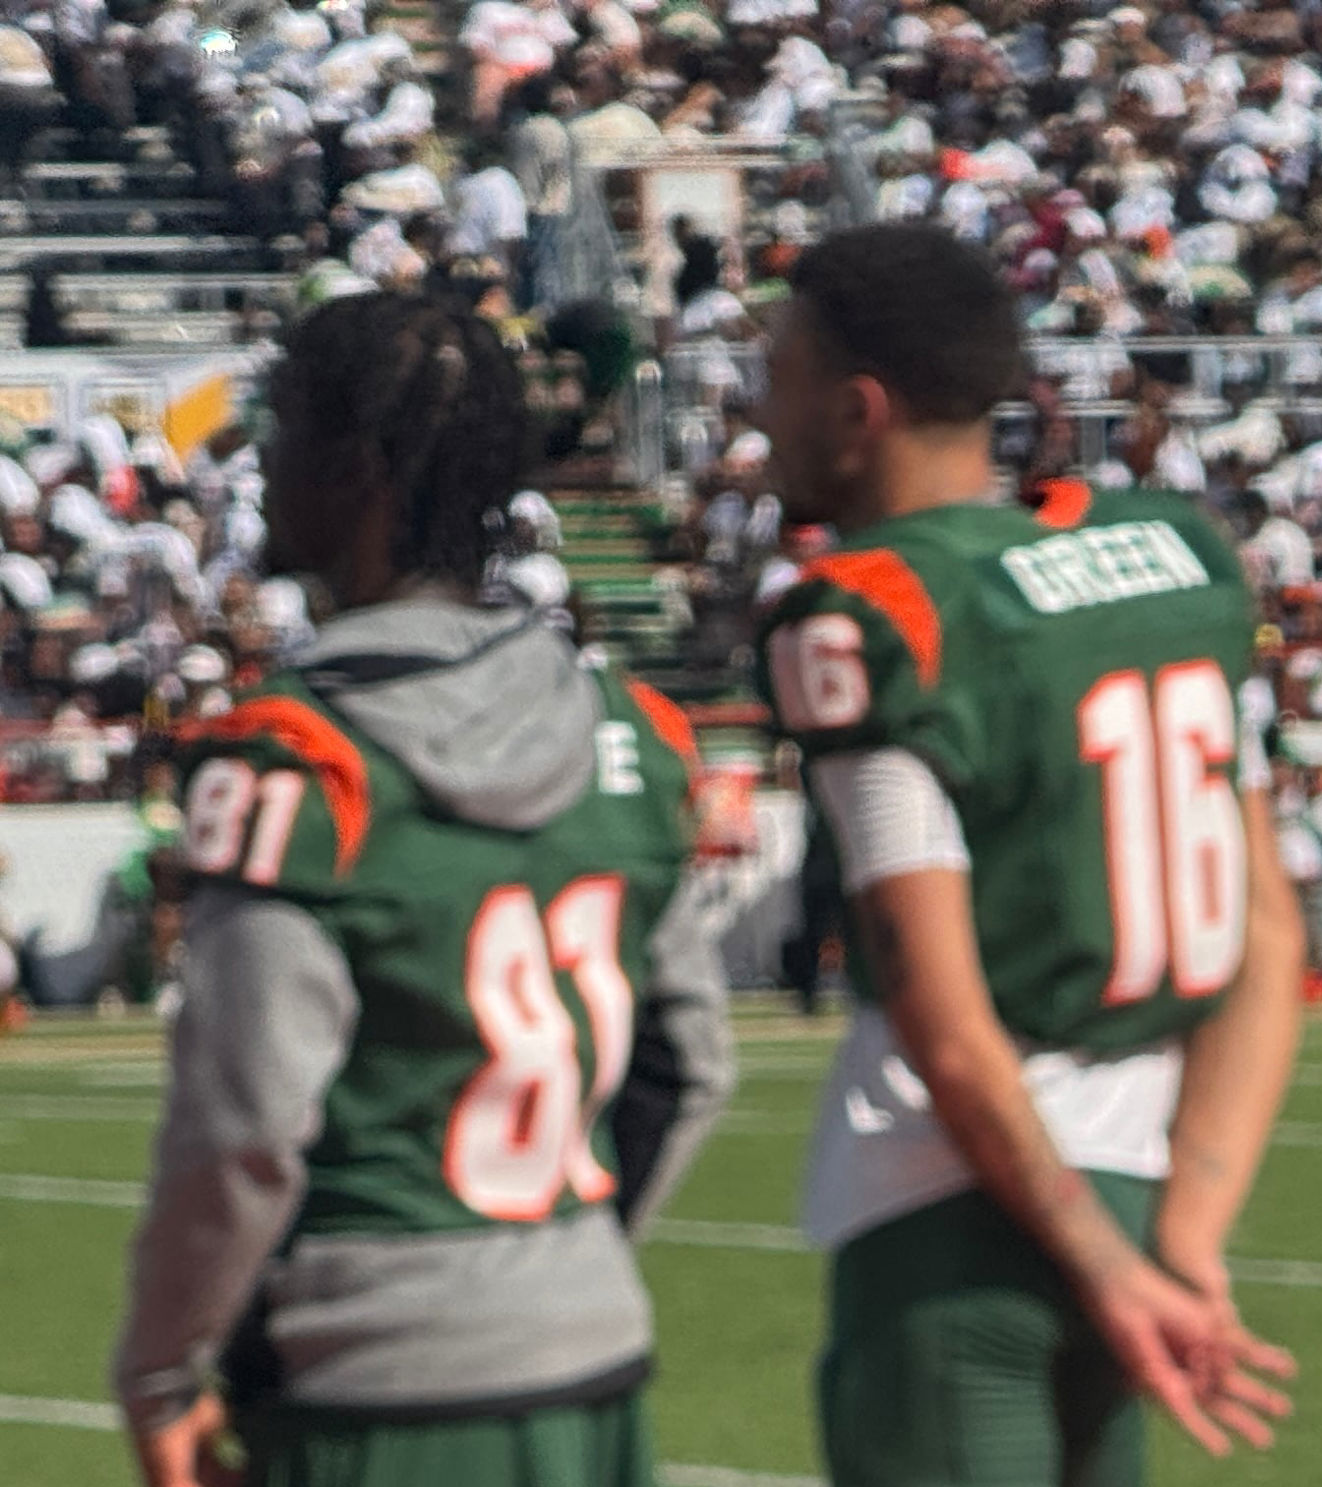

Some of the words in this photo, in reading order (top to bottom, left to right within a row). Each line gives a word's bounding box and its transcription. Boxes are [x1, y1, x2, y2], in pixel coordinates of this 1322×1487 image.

[1001, 520, 1211, 614] GREEN
[182, 757, 304, 887] 81
[1078, 658, 1248, 1004] 16
[442, 870, 634, 1222] 81
